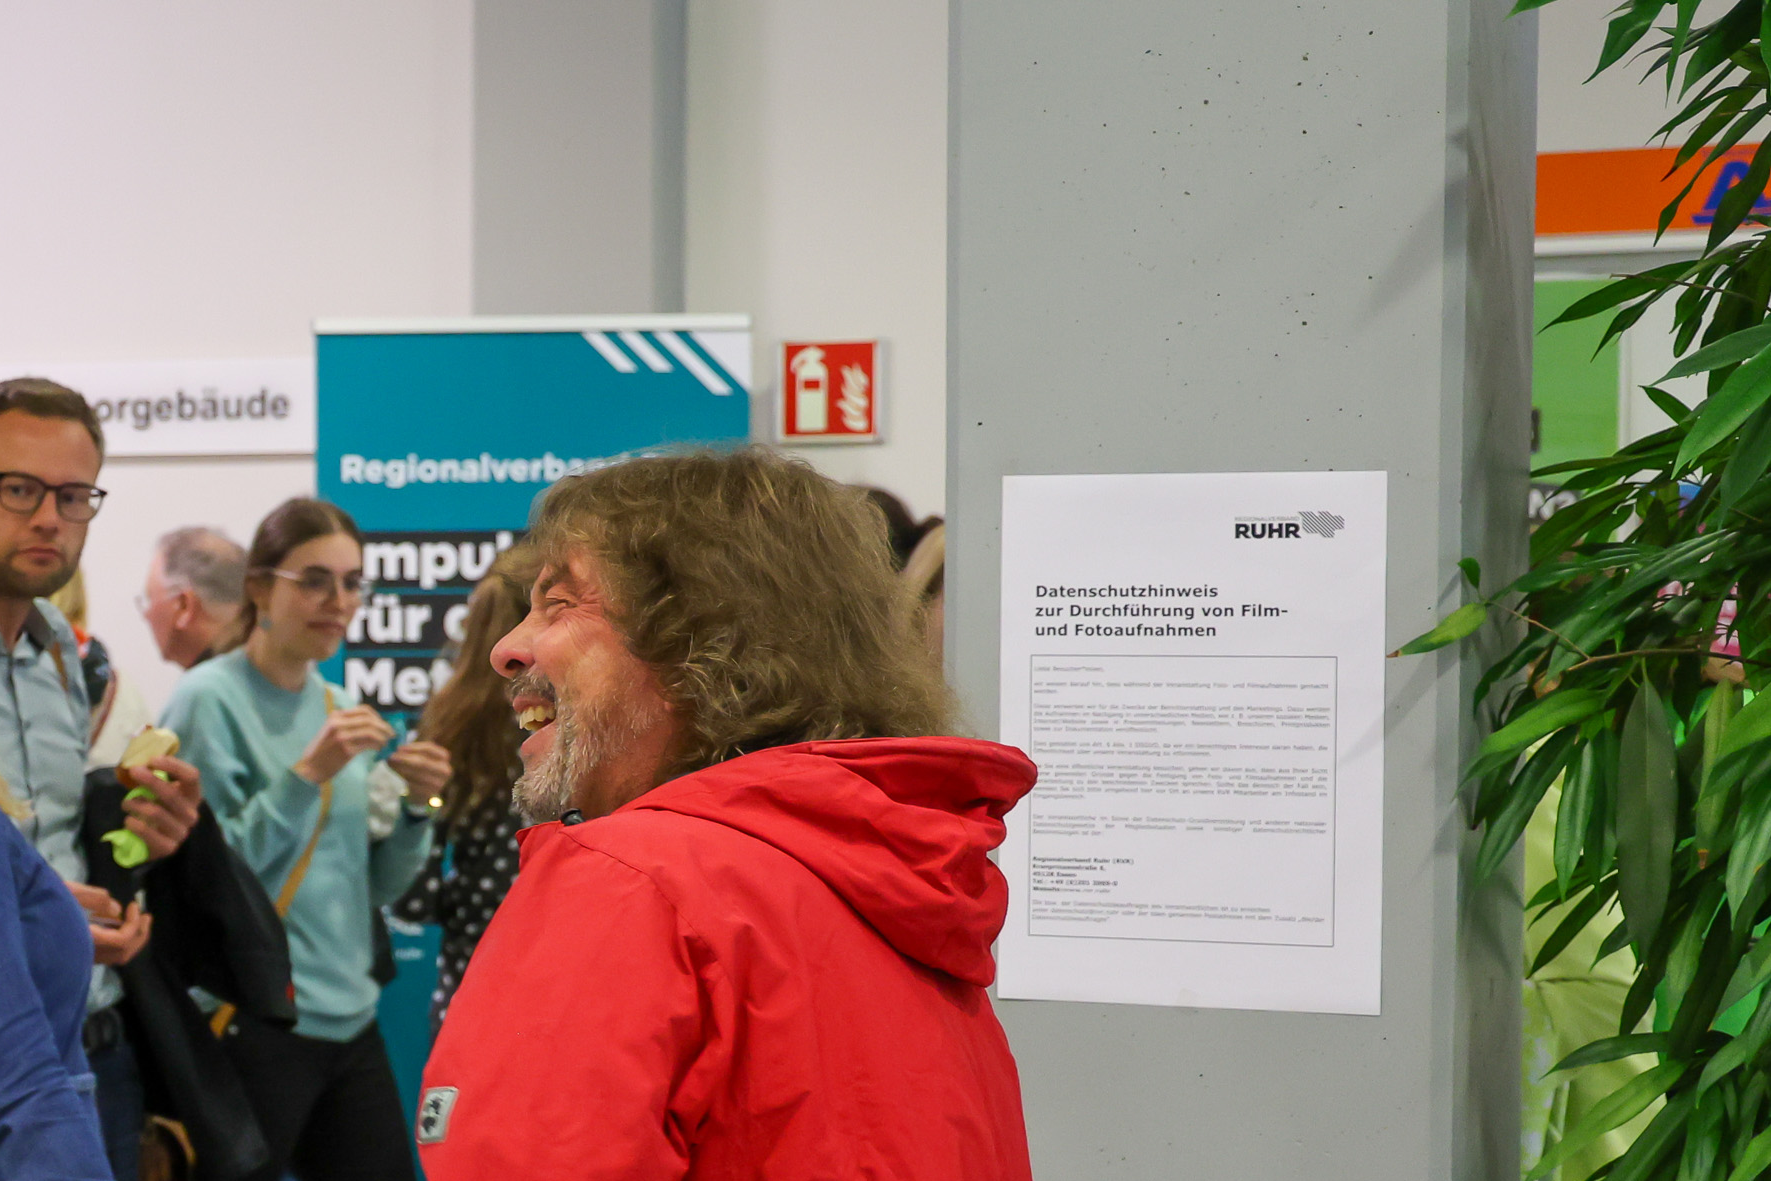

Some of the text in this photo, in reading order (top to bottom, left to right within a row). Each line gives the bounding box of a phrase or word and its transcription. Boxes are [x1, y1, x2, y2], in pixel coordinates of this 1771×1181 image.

[94, 389, 291, 431] orgebäude
[1234, 522, 1302, 540] RUHR
[1034, 584, 1220, 599] Datenschutzhinweis
[1034, 603, 1289, 621] zur Durchführung von Film-
[1034, 622, 1218, 638] und Fotoaufnahmen
